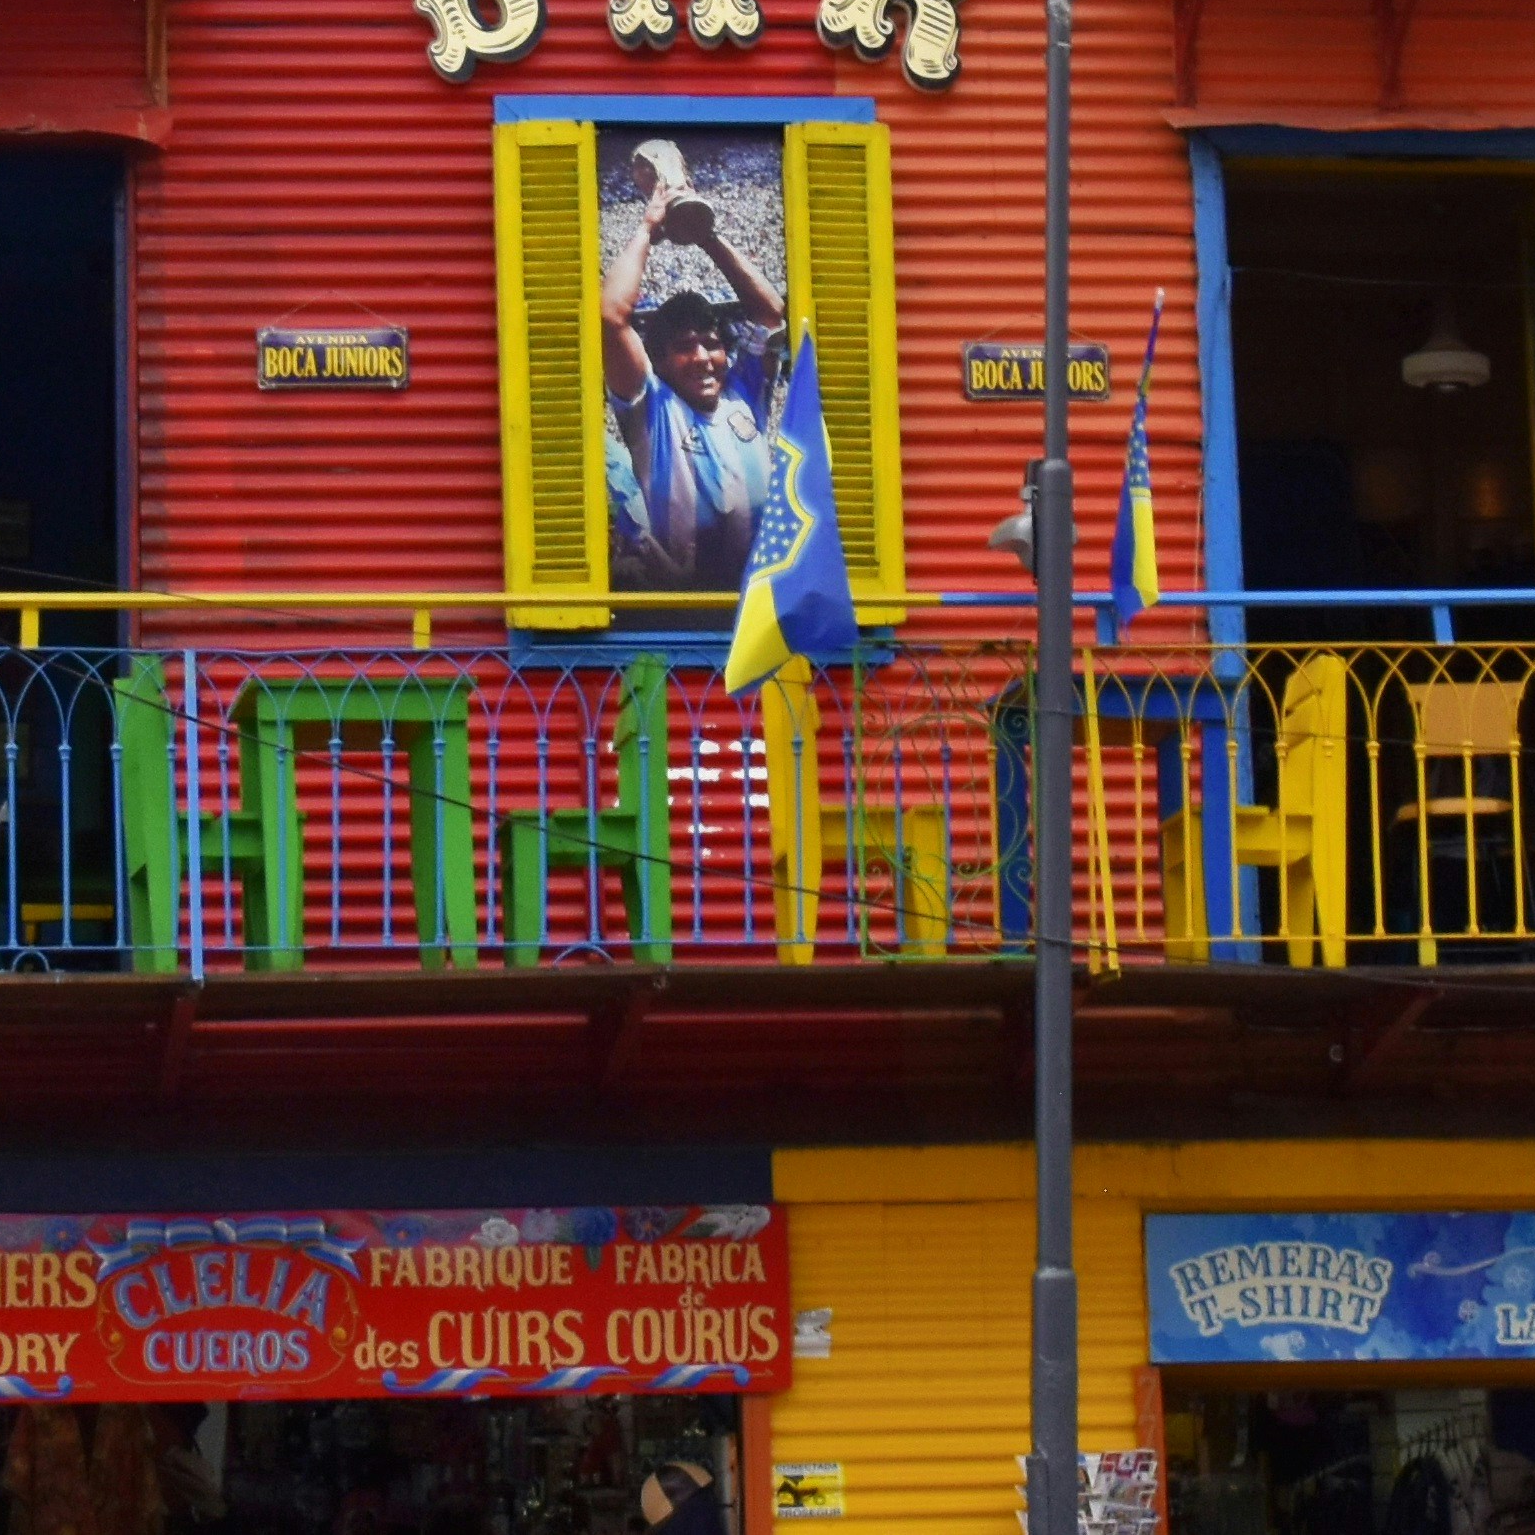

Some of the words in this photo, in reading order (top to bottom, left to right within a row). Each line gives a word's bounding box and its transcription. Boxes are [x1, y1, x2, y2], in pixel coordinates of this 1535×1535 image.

[265, 345, 318, 378] BOCA
[323, 345, 404, 378] JUNIORS
[295, 334, 368, 345] AVENIDA
[970, 358, 1023, 391] BOCA
[370, 1244, 574, 1292] FABRIQUE
[615, 1243, 767, 1290] FABRICA
[1173, 1243, 1389, 1298] REMERAS
[113, 1250, 333, 1334] CLELIA
[678, 1285, 706, 1307] de
[1189, 1283, 1378, 1330] T-SHIRT
[142, 1329, 311, 1377] CUEROS
[353, 1324, 420, 1370] des
[427, 1307, 586, 1371] CUIRS
[606, 1304, 780, 1366] COURUS
